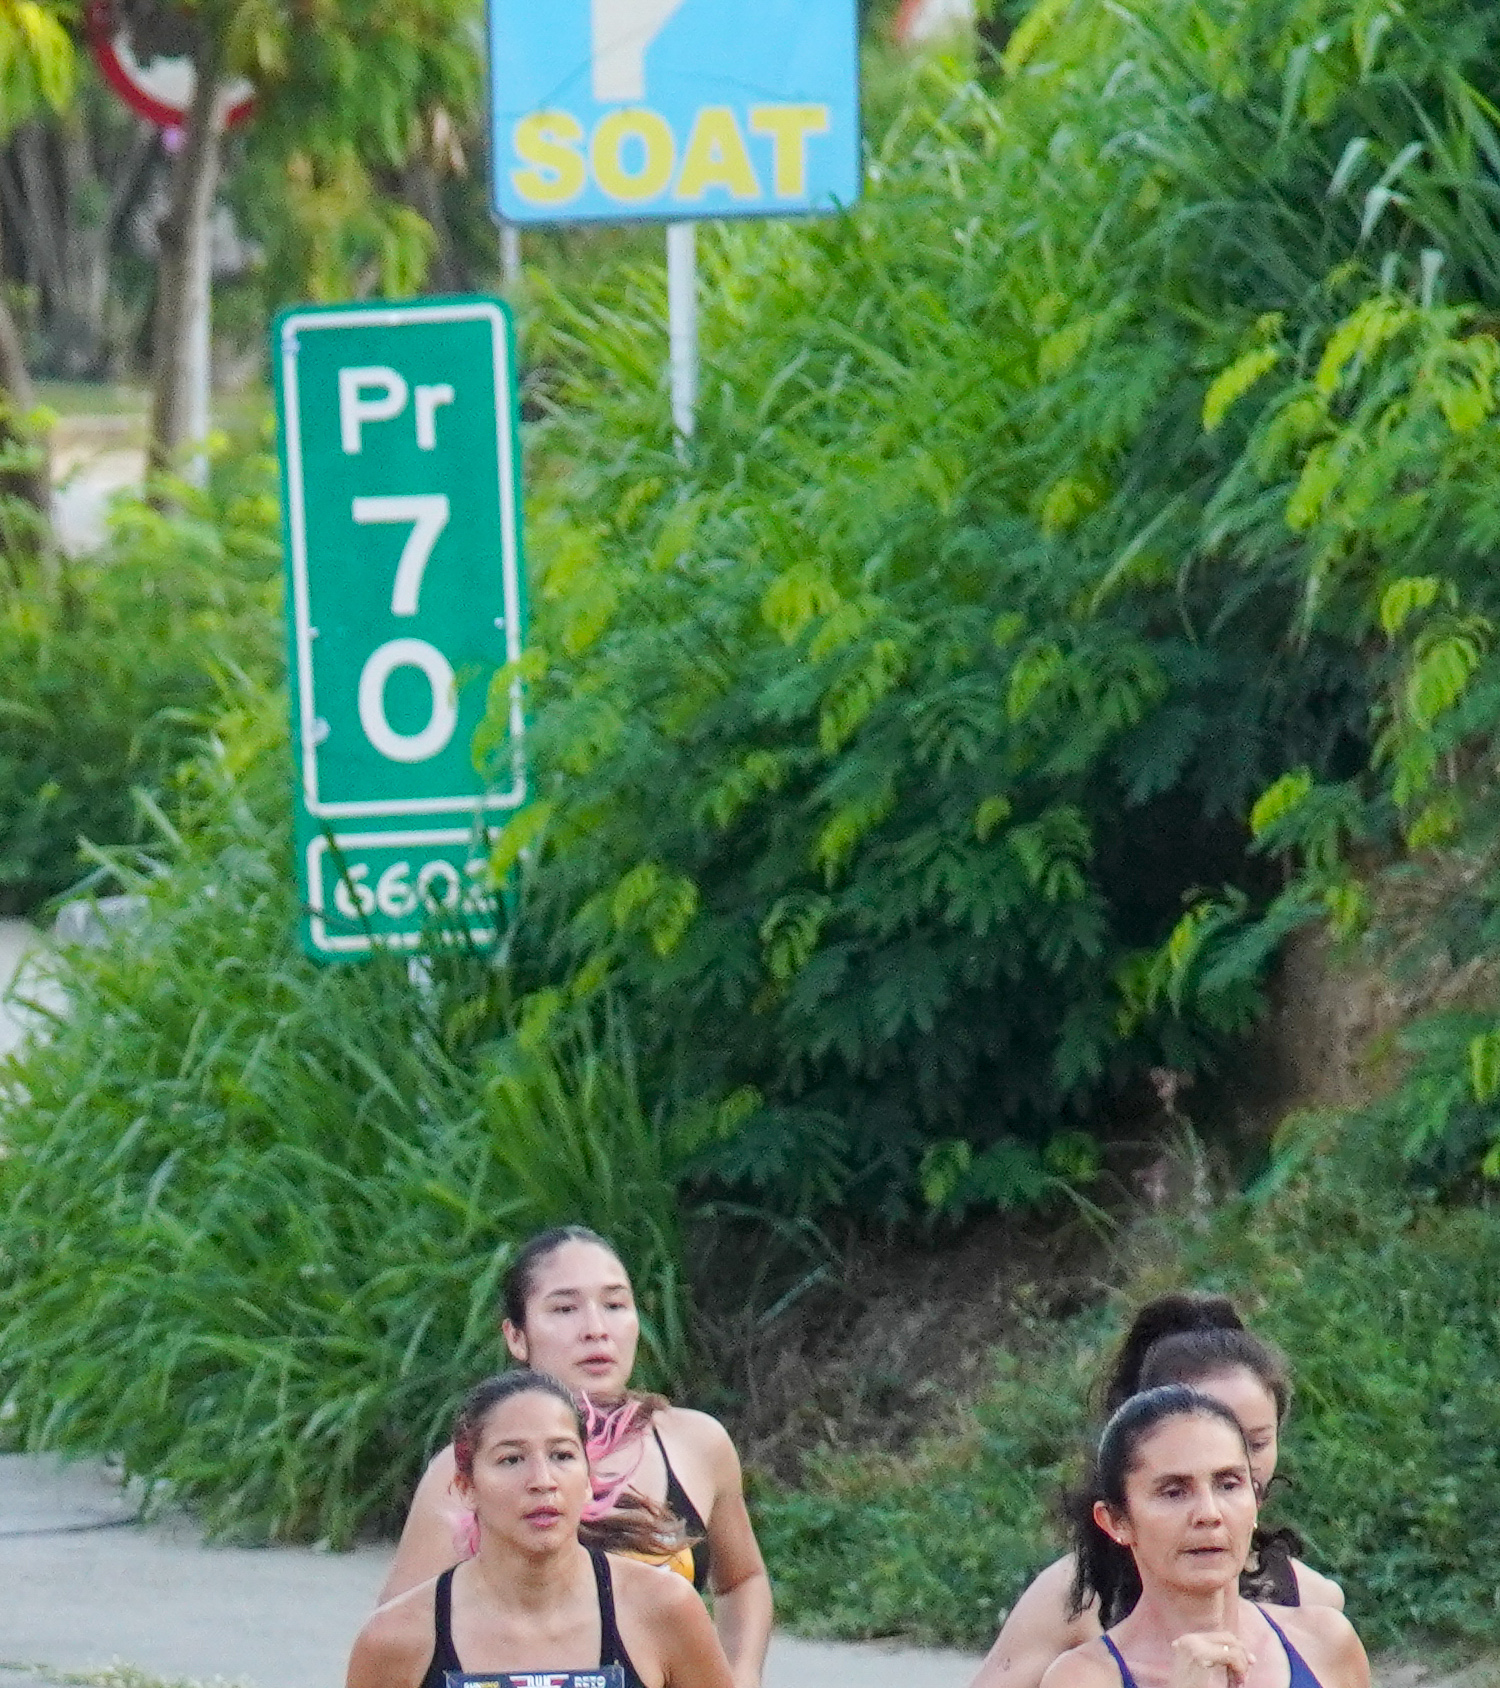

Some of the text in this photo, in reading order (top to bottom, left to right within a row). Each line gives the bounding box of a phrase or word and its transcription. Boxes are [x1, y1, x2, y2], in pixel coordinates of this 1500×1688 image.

[511, 106, 828, 207] SOAT
[338, 365, 456, 456] Pr
[351, 493, 450, 618] 7
[358, 636, 459, 764] 0
